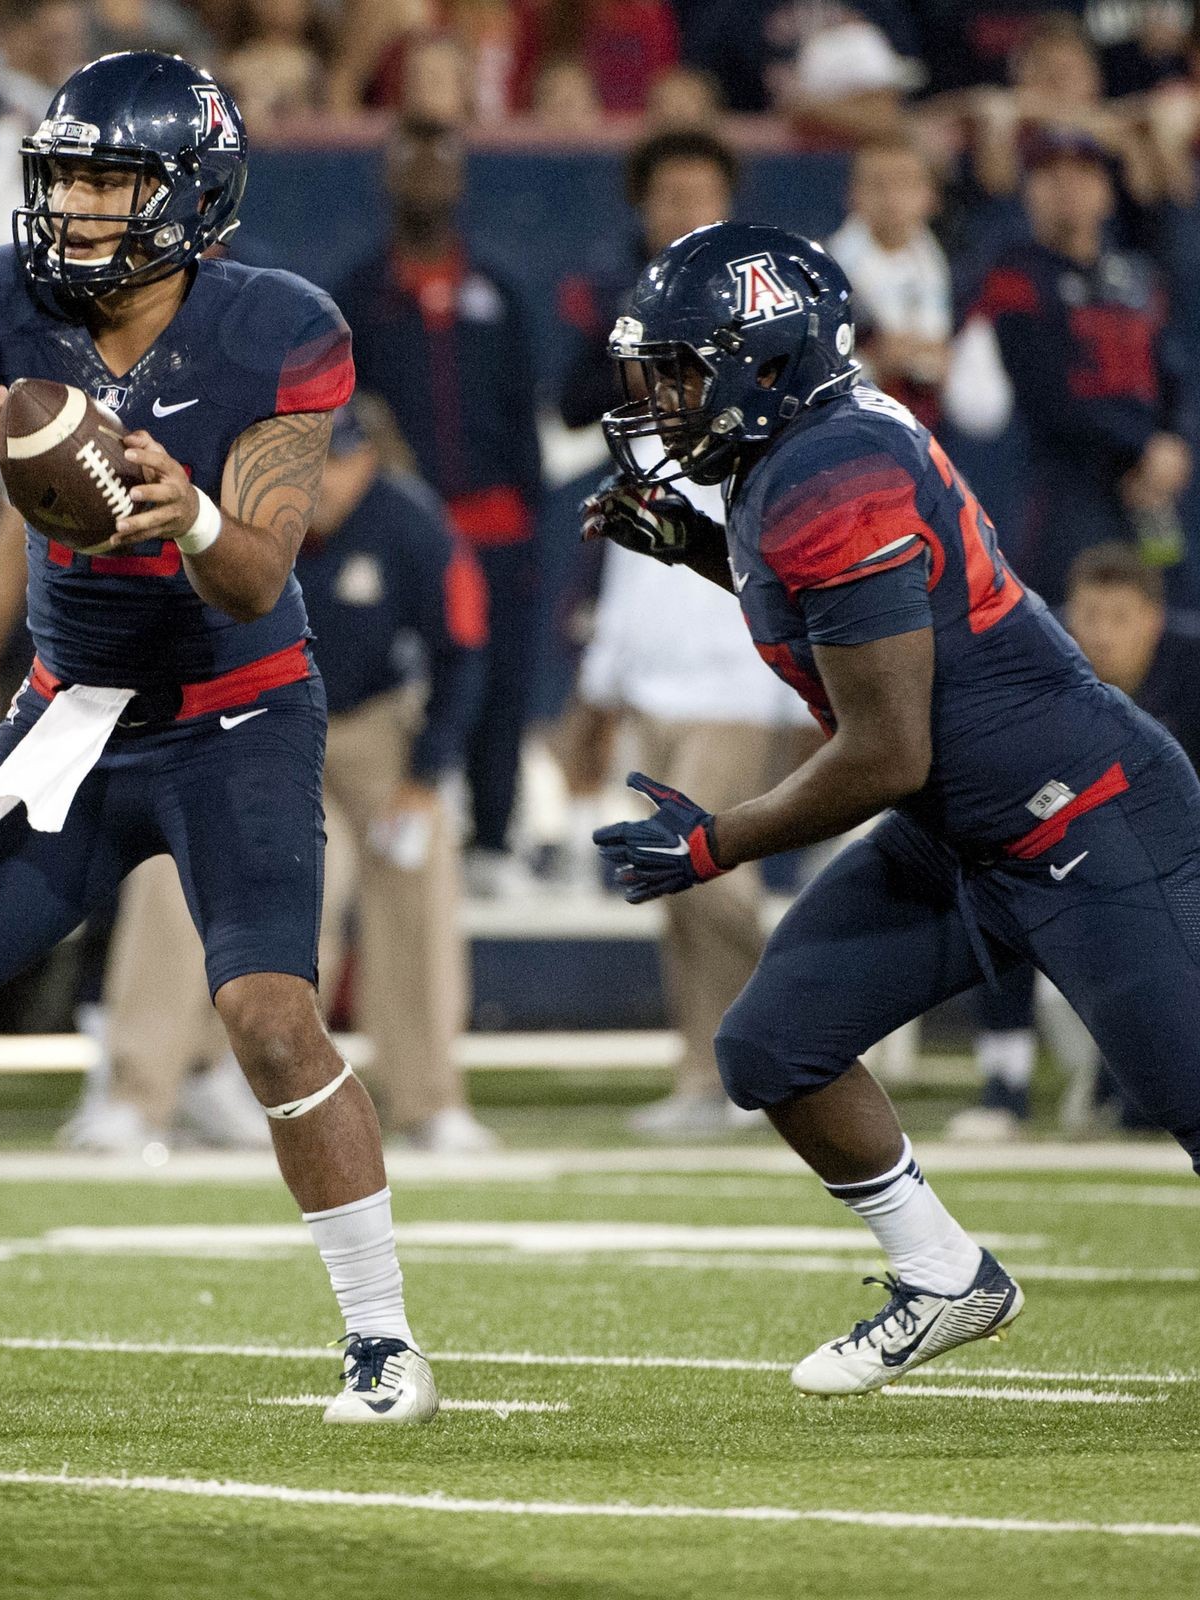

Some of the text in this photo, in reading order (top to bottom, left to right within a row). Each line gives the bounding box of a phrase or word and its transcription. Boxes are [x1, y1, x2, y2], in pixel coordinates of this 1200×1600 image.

[191, 84, 241, 151] A
[726, 252, 804, 329] A
[1035, 794, 1052, 809] 38
